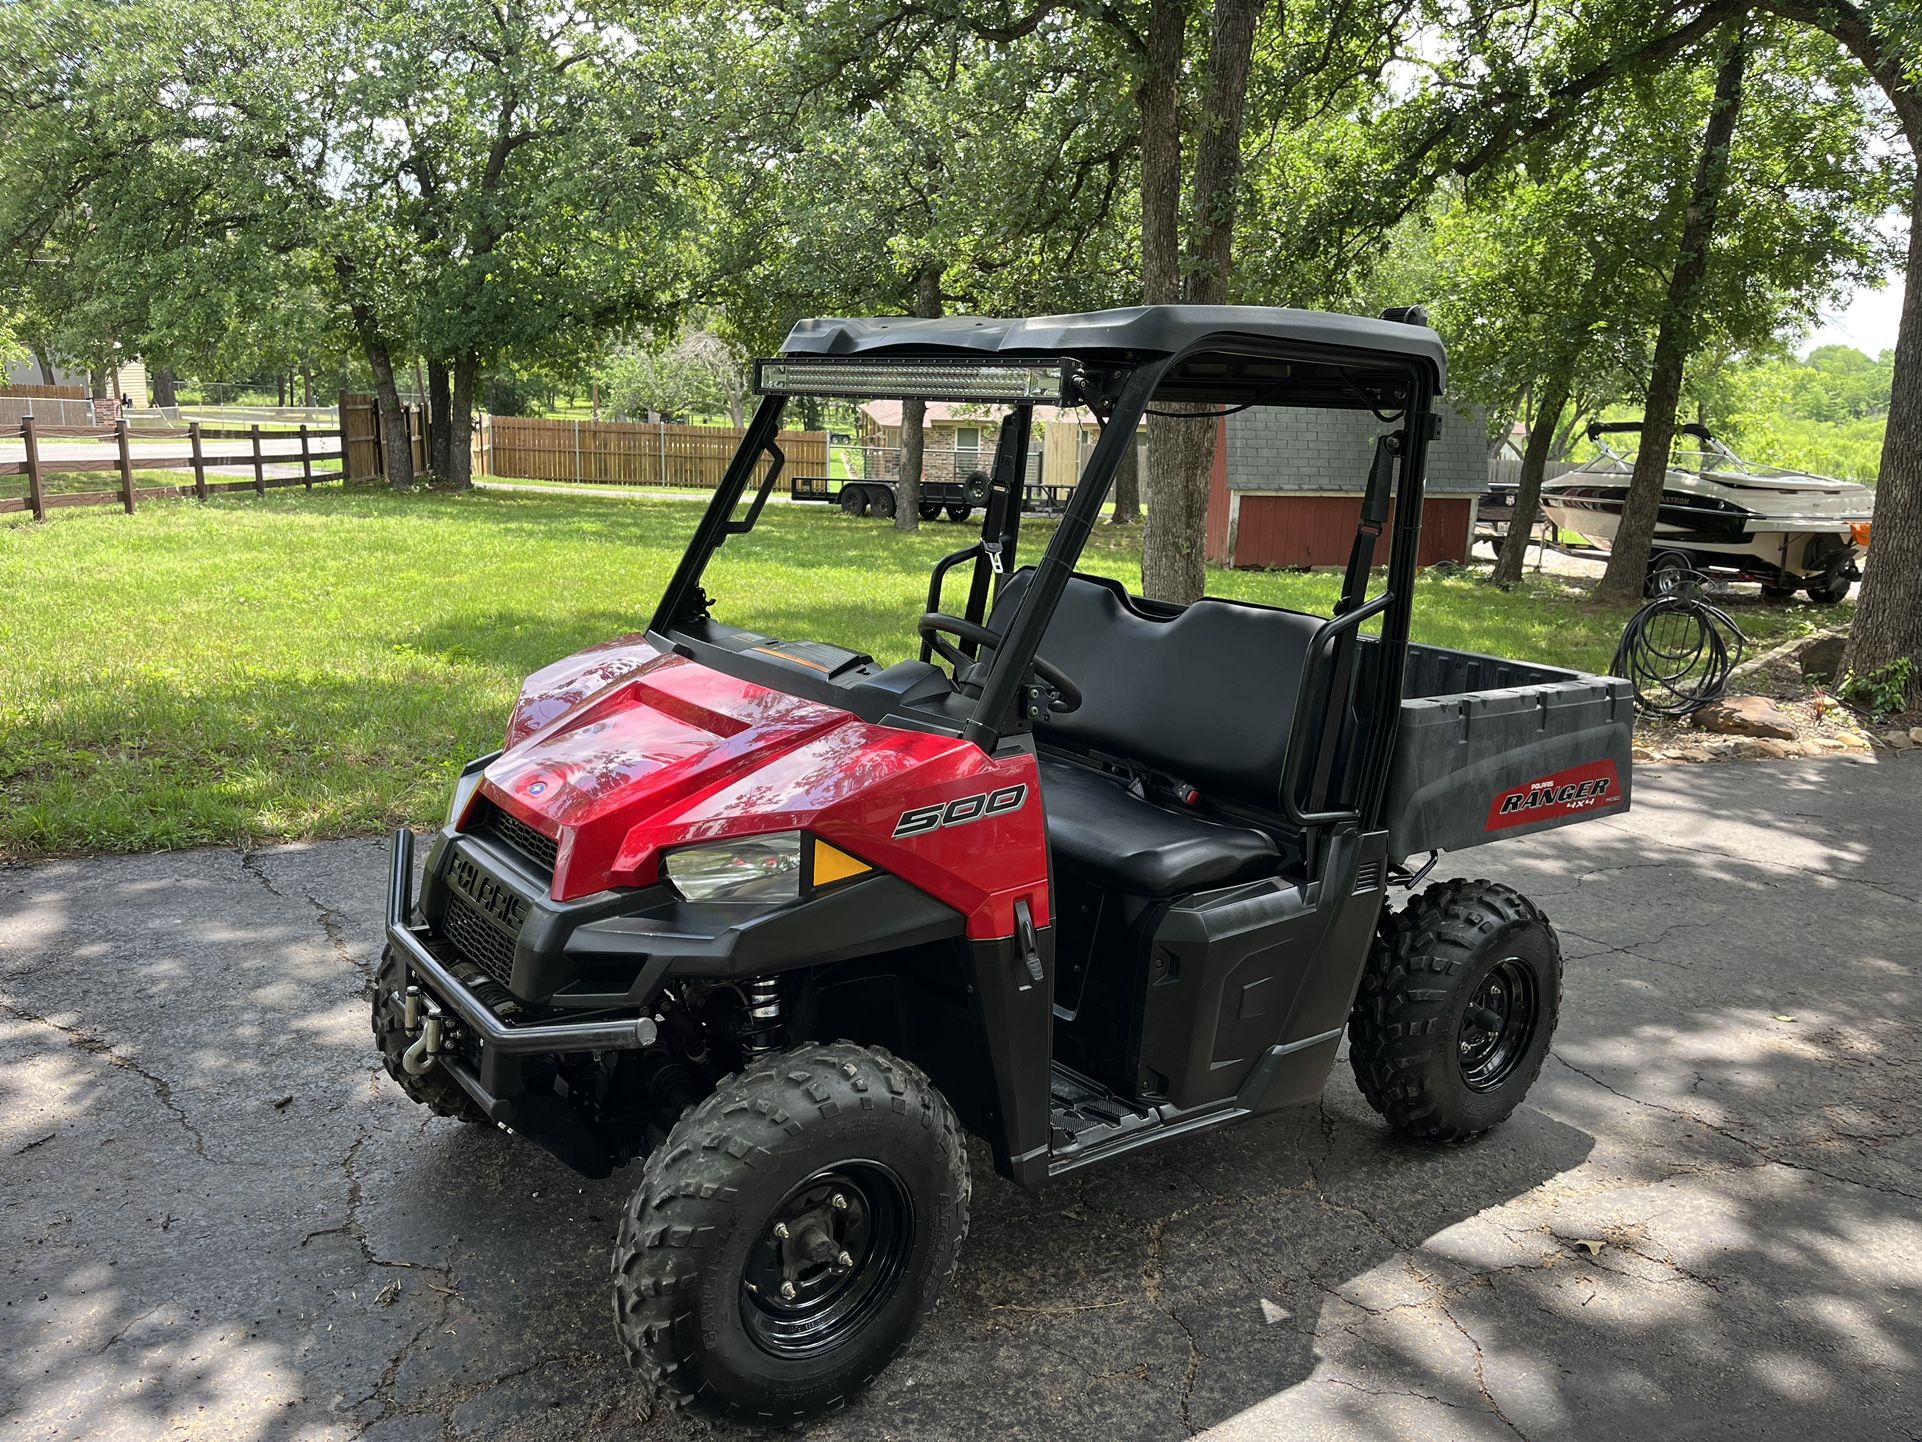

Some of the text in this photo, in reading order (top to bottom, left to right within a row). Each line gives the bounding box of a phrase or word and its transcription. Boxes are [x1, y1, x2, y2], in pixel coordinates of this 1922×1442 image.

[1500, 778, 1610, 815] RANGER
[1531, 781, 1554, 790] POLARIS
[892, 783, 1028, 839] 500
[448, 851, 525, 929] POLARIS
